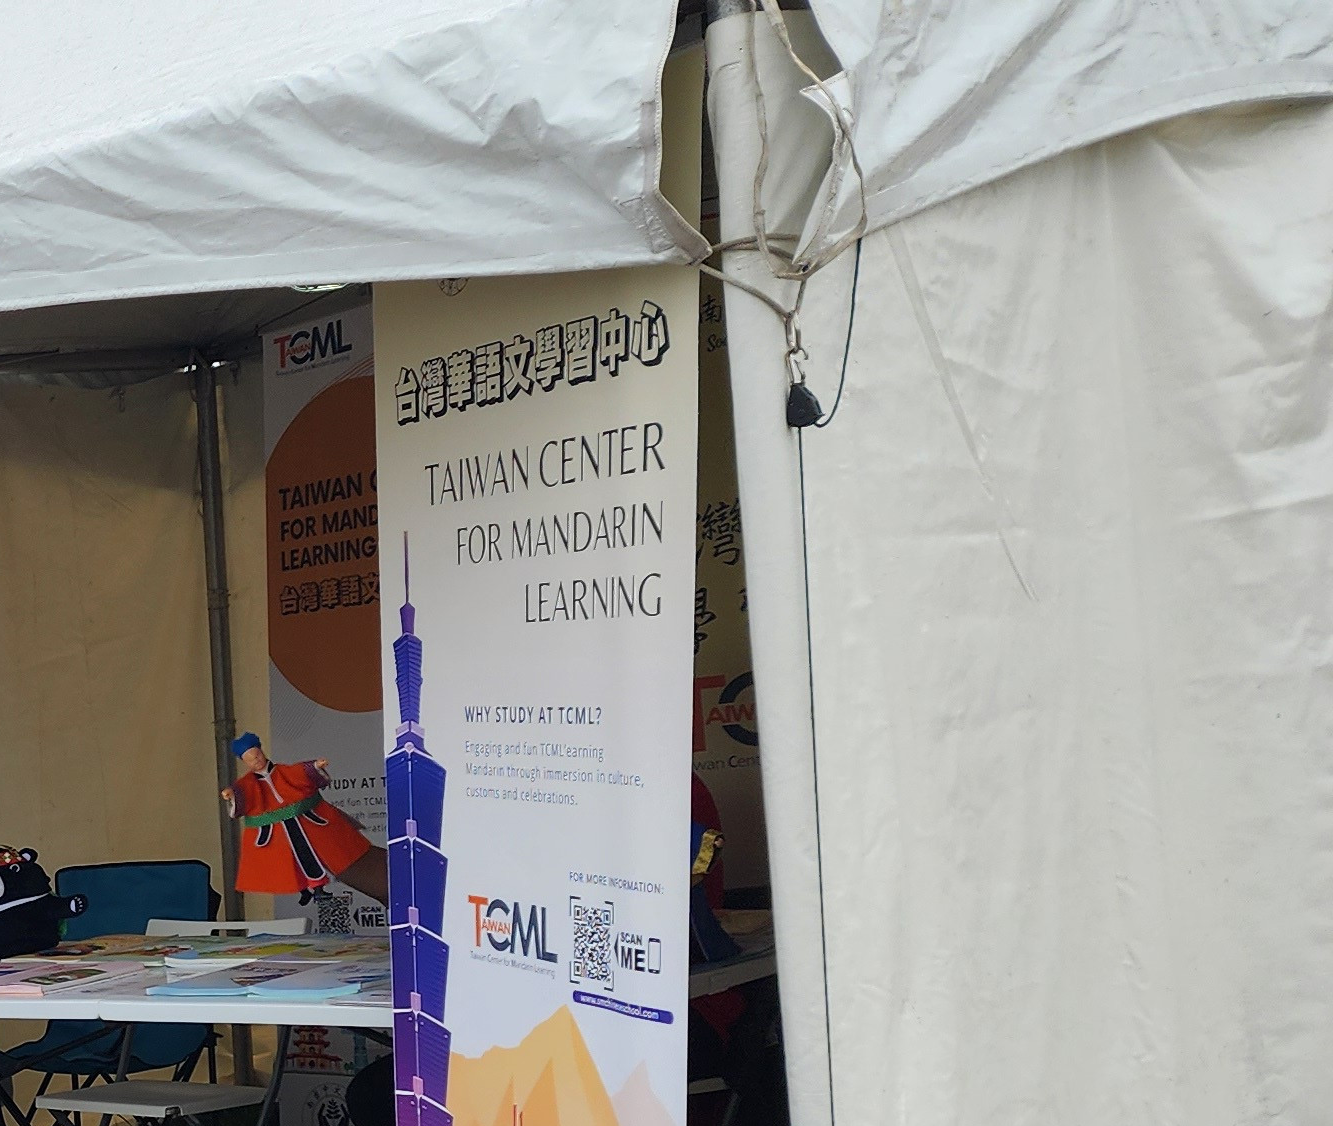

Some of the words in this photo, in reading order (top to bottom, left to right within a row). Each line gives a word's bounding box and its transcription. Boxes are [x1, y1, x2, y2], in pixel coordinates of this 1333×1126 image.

[394, 299, 671, 427] 台灣華語文學習中心
[424, 444, 530, 506] TAIWAN
[539, 421, 665, 487] CENTER
[278, 472, 363, 510] TAIWAN
[280, 516, 317, 542] FOR
[456, 522, 503, 565] FOR
[511, 501, 663, 560] MANDARIN
[281, 536, 377, 571] LEARNING
[525, 572, 662, 624] LEARNING
[464, 706, 491, 723] WHY
[495, 706, 534, 724] STUDY
[538, 706, 554, 724] AT
[558, 706, 602, 725] TCML?
[465, 741, 502, 758] Engaging
[504, 741, 520, 756] and
[523, 741, 538, 756] fun
[361, 777, 376, 789] AT
[466, 762, 506, 776] Mandarin
[507, 765, 541, 782] through
[543, 766, 593, 783] immersion
[596, 770, 606, 783] in
[608, 771, 644, 788] culture,
[466, 786, 500, 799] customs
[502, 787, 518, 800] and
[521, 788, 578, 805] celebrations.
[570, 871, 584, 883] FOR
[586, 873, 608, 886] MORE
[609, 876, 664, 895] INFORMATION:
[468, 894, 558, 963] TCML
[620, 931, 642, 946] SCAN
[621, 945, 646, 972] ME
